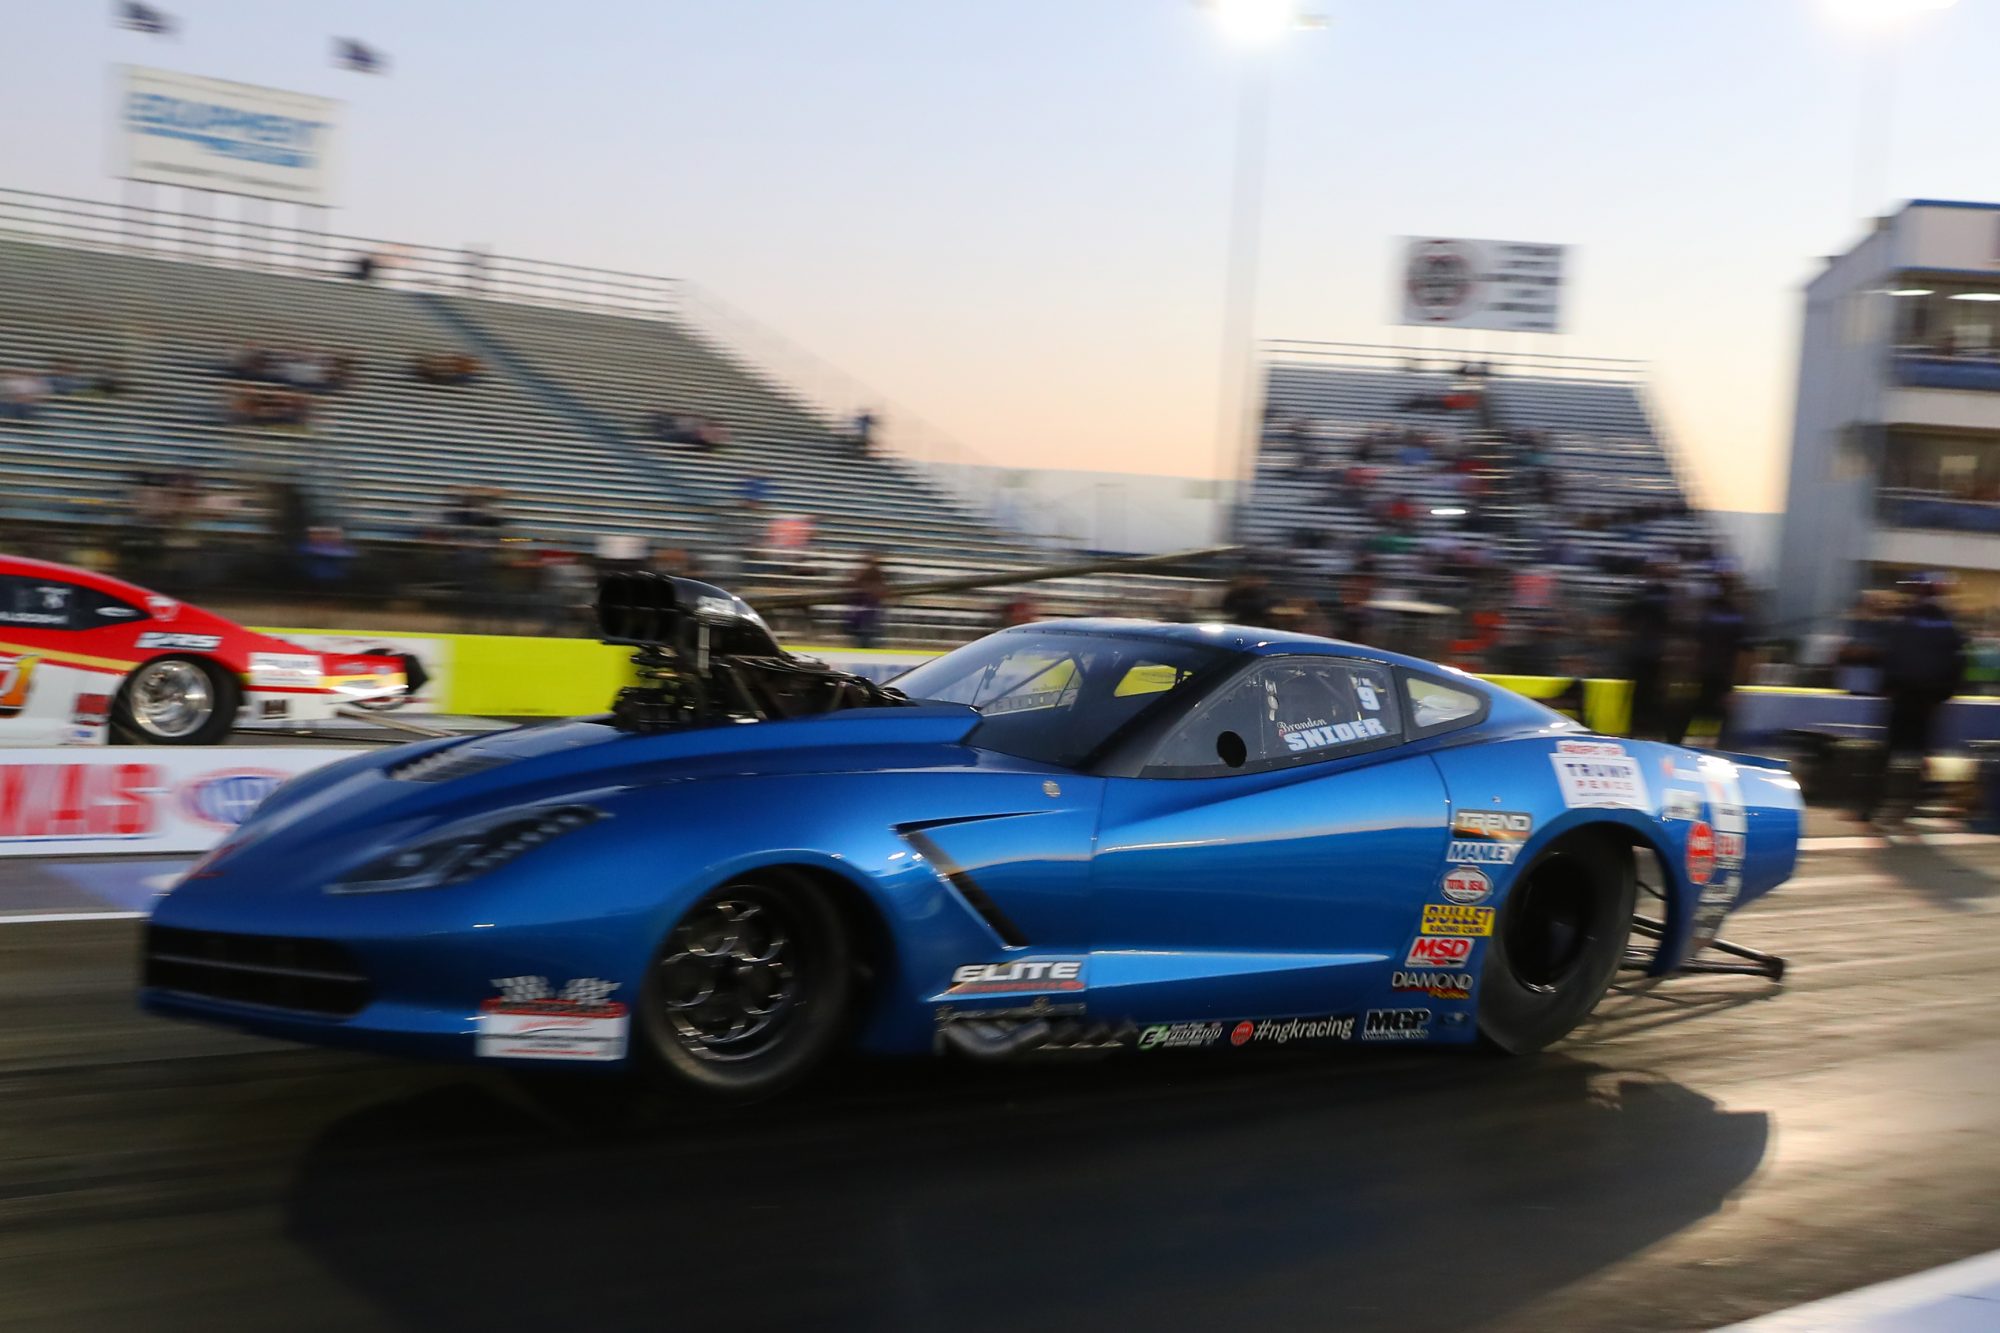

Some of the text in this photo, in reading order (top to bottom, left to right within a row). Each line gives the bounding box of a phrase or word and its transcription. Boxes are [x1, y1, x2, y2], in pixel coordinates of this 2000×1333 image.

[1357, 686, 1381, 711] 9
[1277, 717, 1328, 733] Brandon
[1283, 718, 1387, 751] SNIDER
[1563, 763, 1632, 778] TRUMP
[1457, 812, 1531, 834] TREND
[1425, 906, 1492, 925] BULLET
[1411, 938, 1470, 958] MSD
[952, 962, 1081, 982] ELITE
[1392, 971, 1474, 990] DIAMOND
[1254, 1016, 1355, 1044] #ngkracing
[1364, 1008, 1432, 1033] MGP
